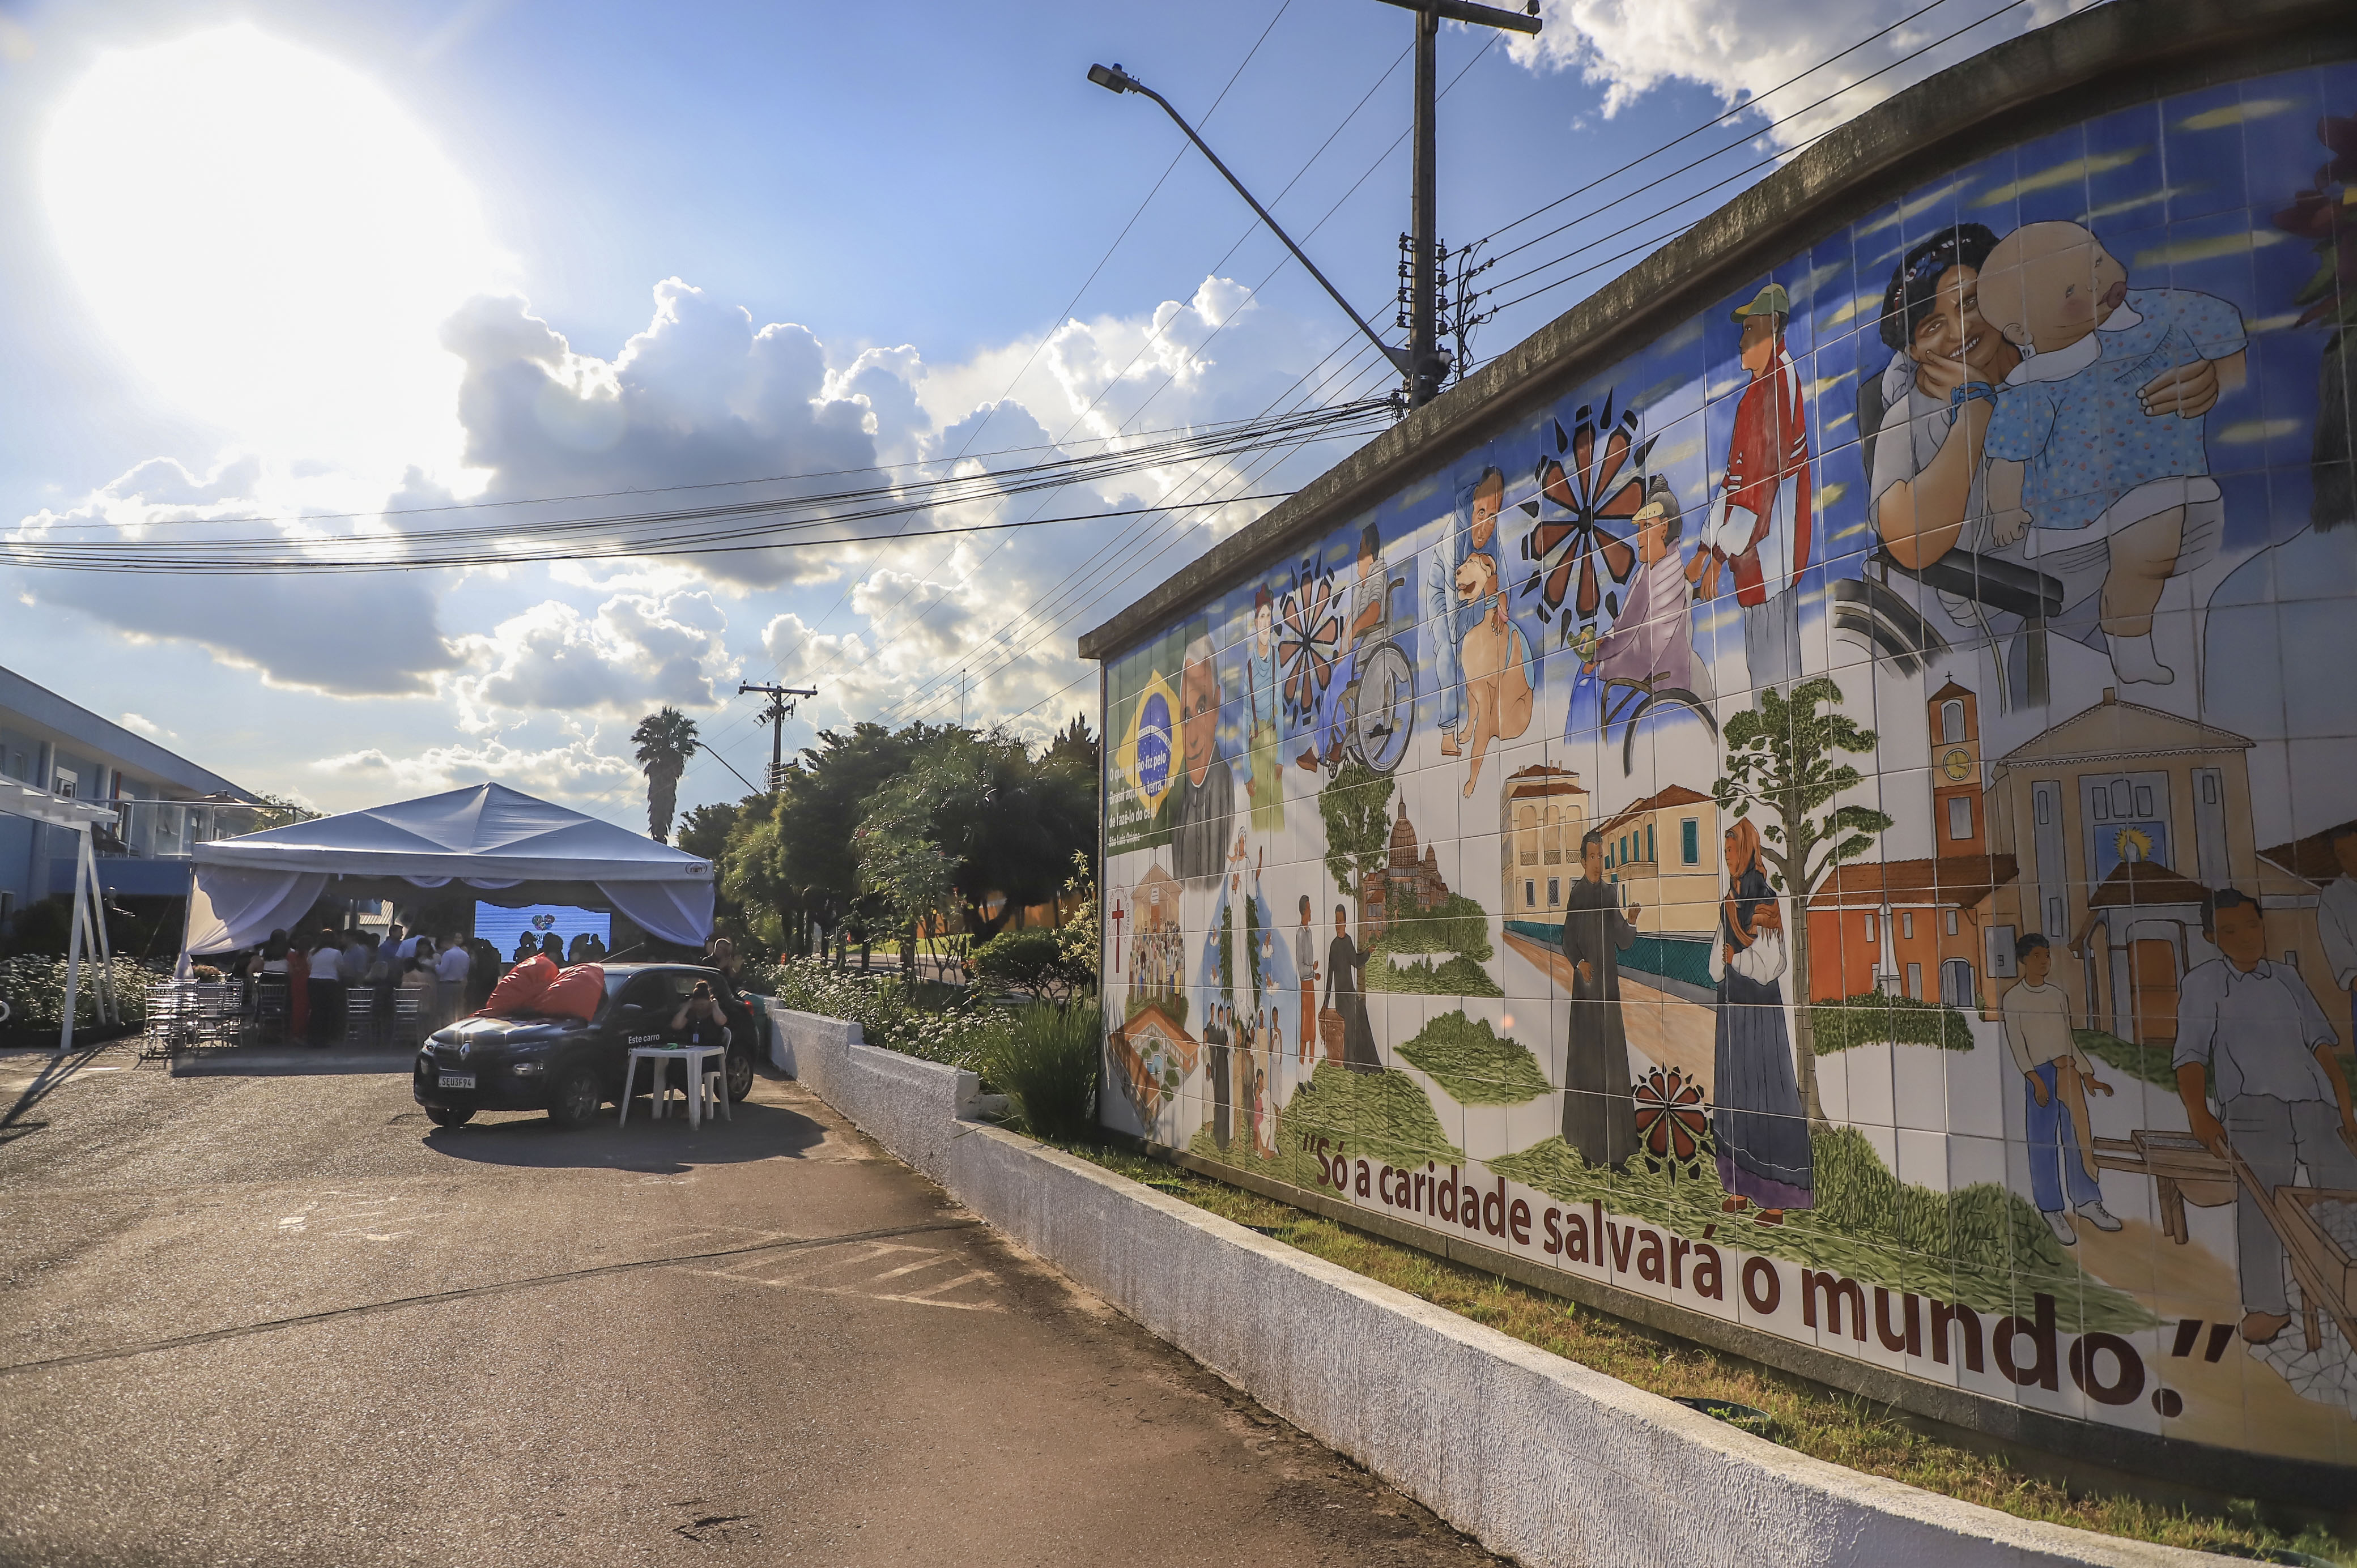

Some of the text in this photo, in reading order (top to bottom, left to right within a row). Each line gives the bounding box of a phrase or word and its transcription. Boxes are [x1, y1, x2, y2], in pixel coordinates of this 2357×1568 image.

[1109, 768, 1114, 782] O
[1114, 767, 1125, 783] que
[1154, 750, 1166, 770] pelo
[1109, 787, 1125, 806] Brasil
[1125, 786, 1137, 803] aqui
[1147, 779, 1163, 794] terra,
[1109, 815, 1116, 829] de
[1116, 810, 1134, 826] fazê-lo
[1135, 807, 1142, 822] do
[1126, 831, 1141, 843] Orione
[628, 1036, 643, 1045] Este
[442, 1077, 471, 1087] SEU3F94
[1303, 1133, 2236, 1418] "Só a caridade salvará o mundo."
